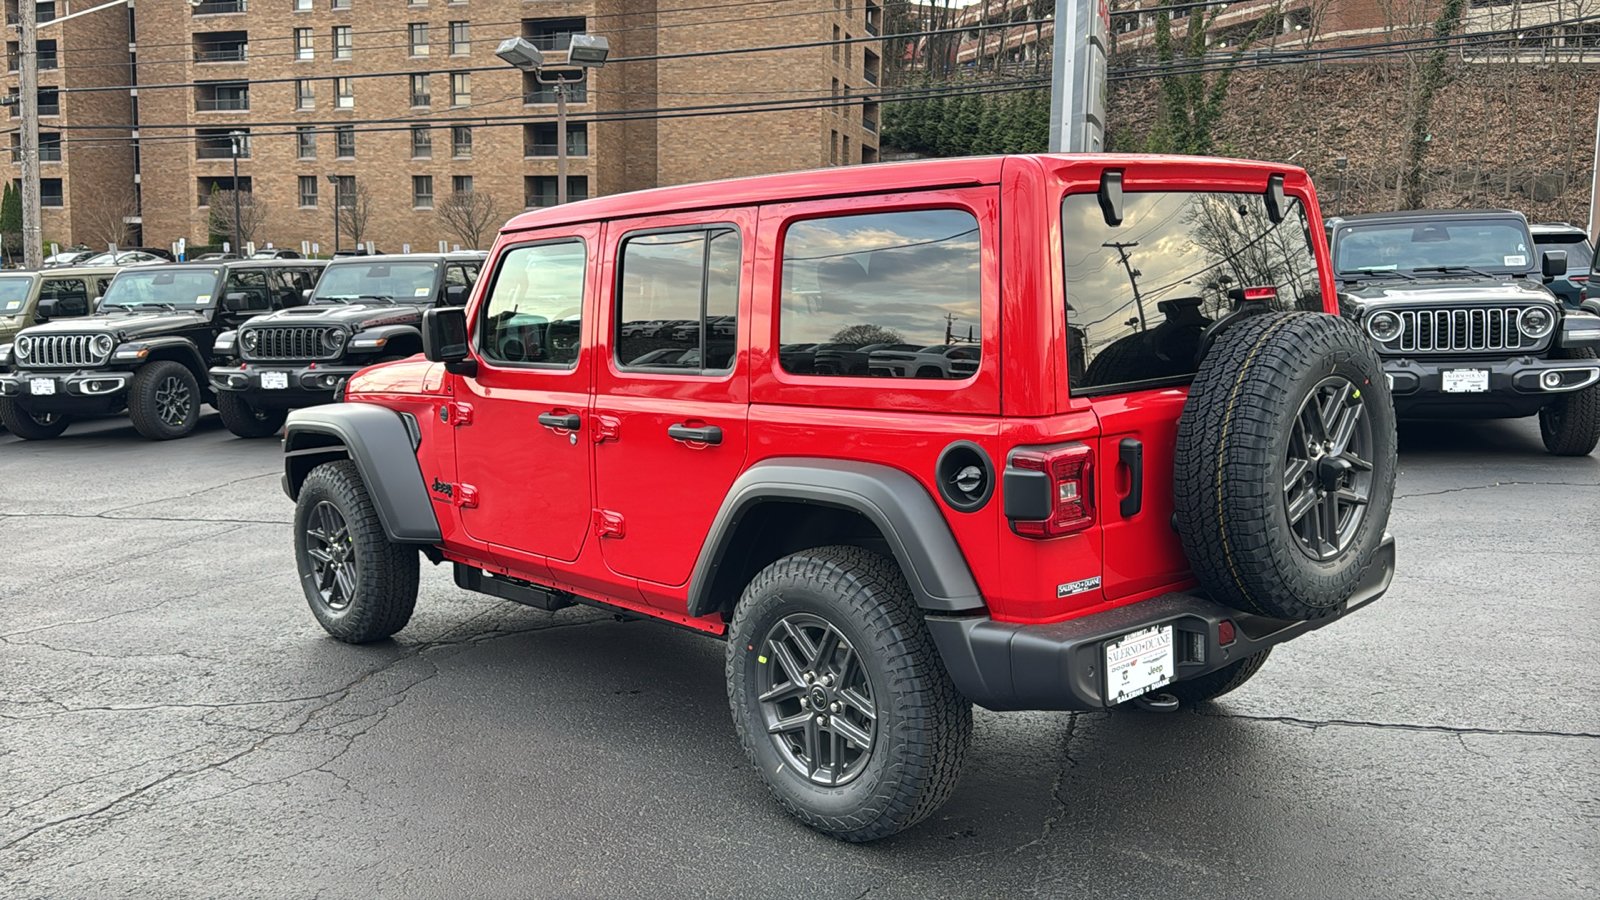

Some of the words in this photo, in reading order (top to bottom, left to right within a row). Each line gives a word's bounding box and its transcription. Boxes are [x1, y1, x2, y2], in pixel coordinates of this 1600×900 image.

[431, 476, 453, 498] Jeep
[1108, 642, 1142, 664] SALERNO
[1145, 632, 1171, 651] DUANE
[1148, 664, 1163, 676] Jeep
